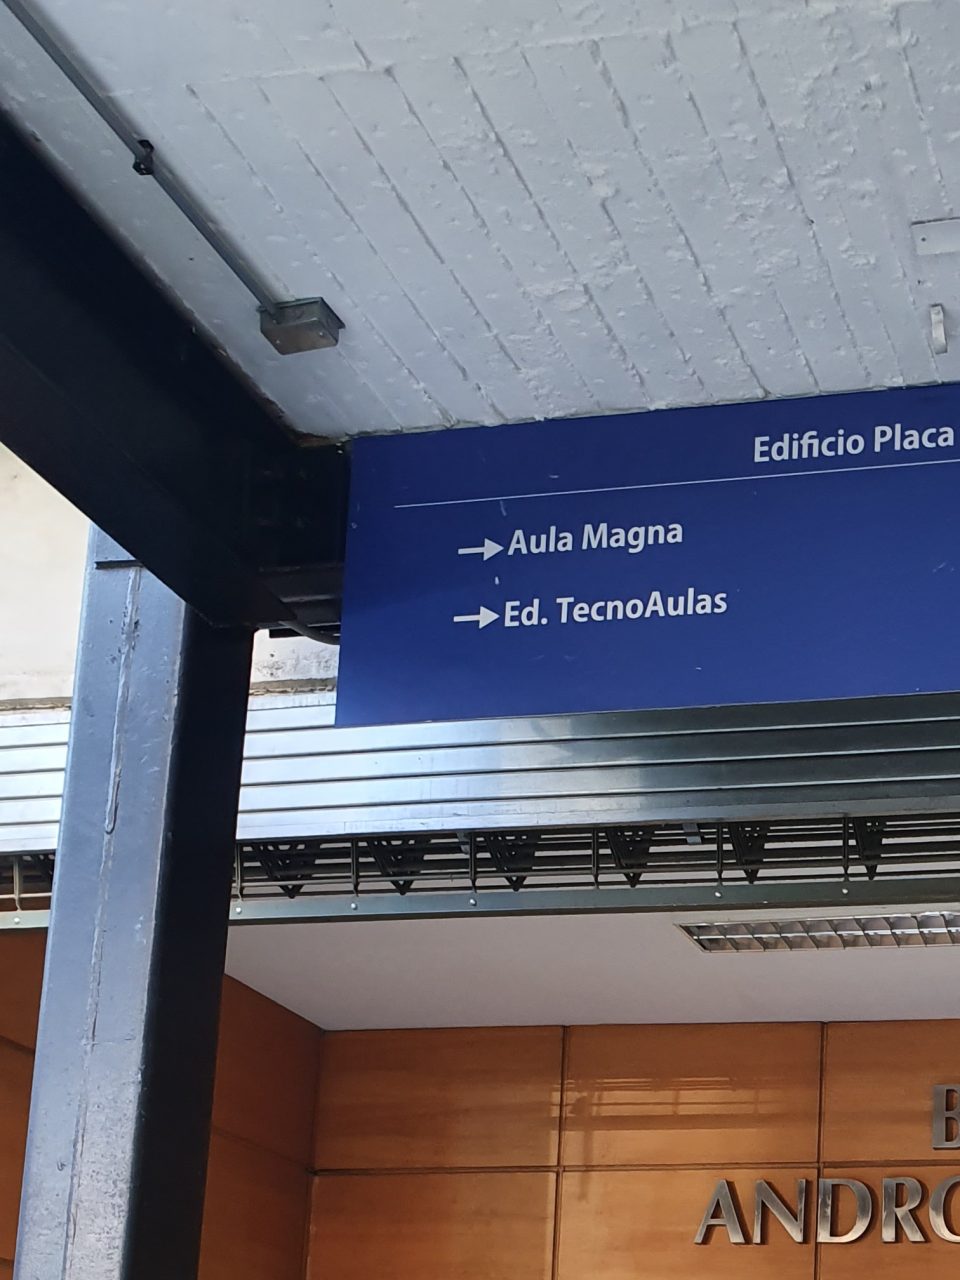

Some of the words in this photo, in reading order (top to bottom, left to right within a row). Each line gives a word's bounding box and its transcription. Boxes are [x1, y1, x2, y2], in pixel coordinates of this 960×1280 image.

[754, 429, 865, 463] Edificio
[874, 423, 954, 453] Placa
[507, 525, 573, 556] Aula
[581, 522, 683, 554] Magna
[504, 598, 548, 627] Ed.
[555, 587, 728, 624] TecnoAulas
